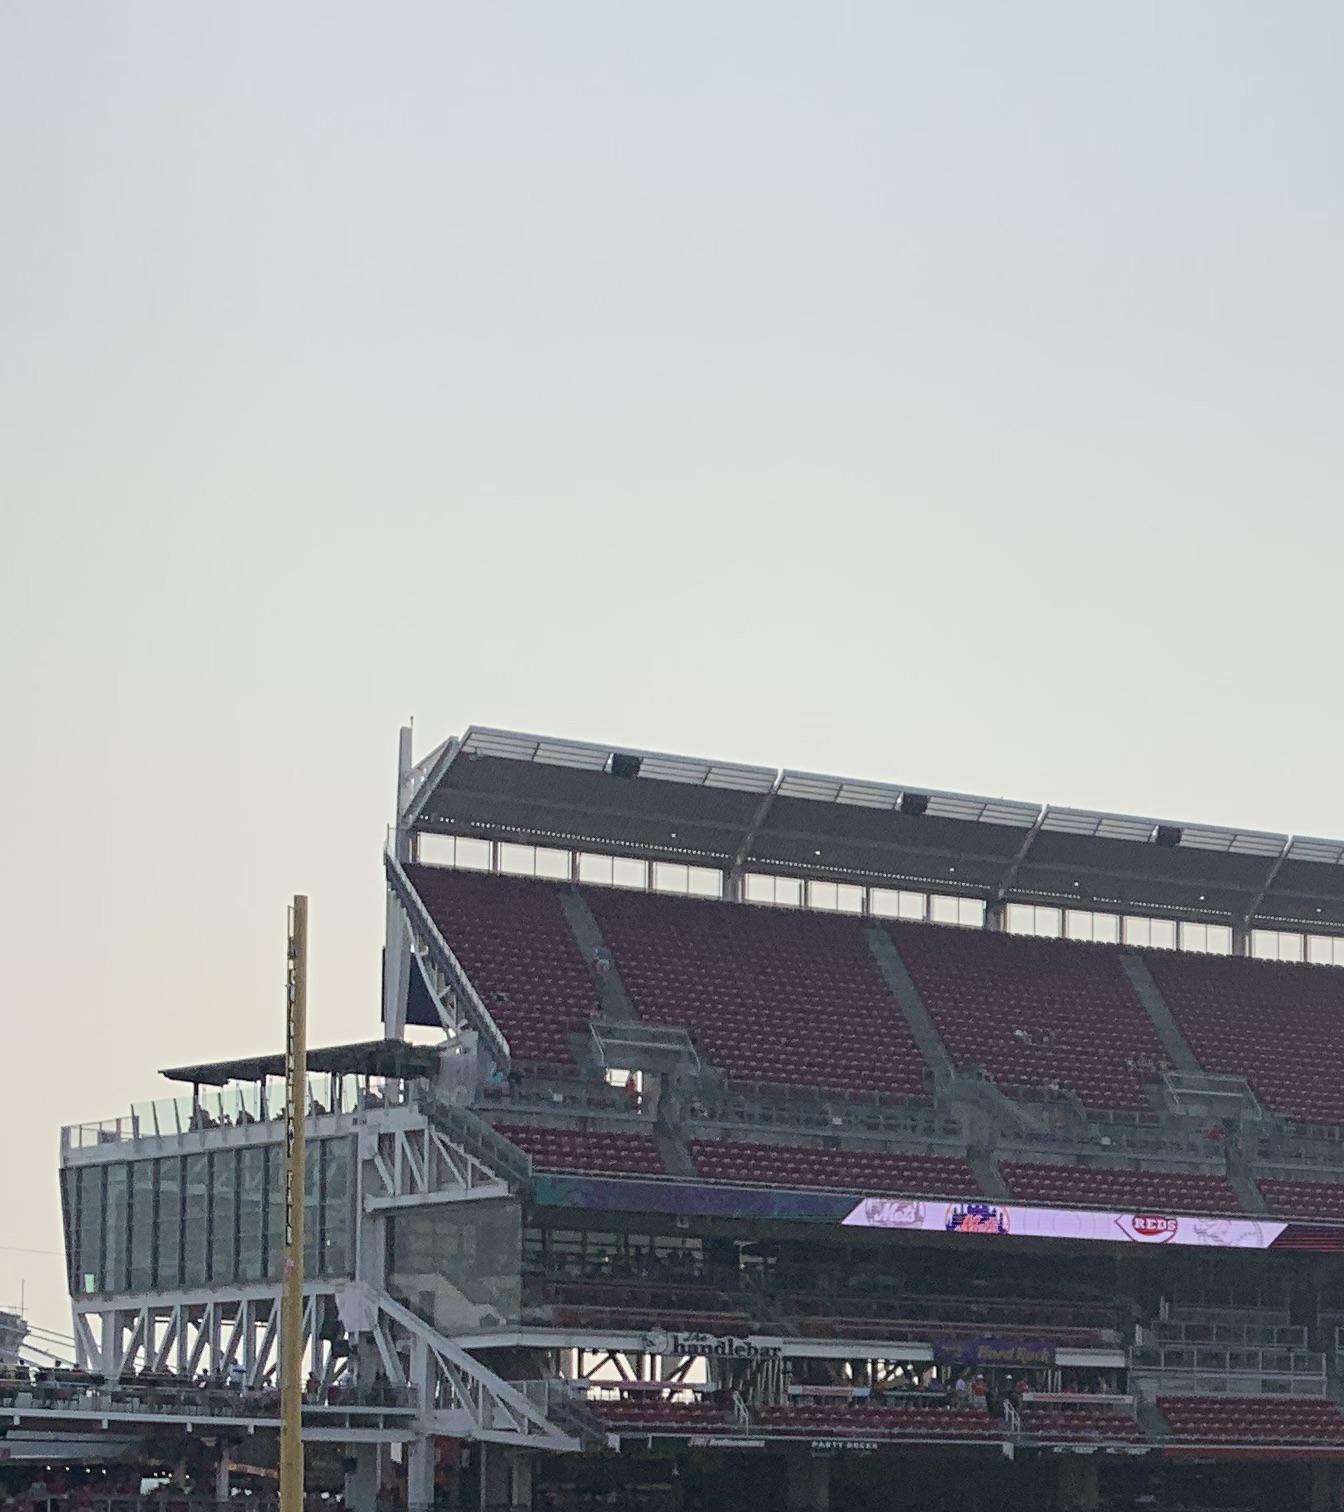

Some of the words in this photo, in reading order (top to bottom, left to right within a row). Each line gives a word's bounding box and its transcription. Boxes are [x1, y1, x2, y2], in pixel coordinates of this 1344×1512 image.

[1133, 1217, 1178, 1232] REDS
[671, 1334, 783, 1357] handlebar
[811, 1440, 843, 1449] PARTY
